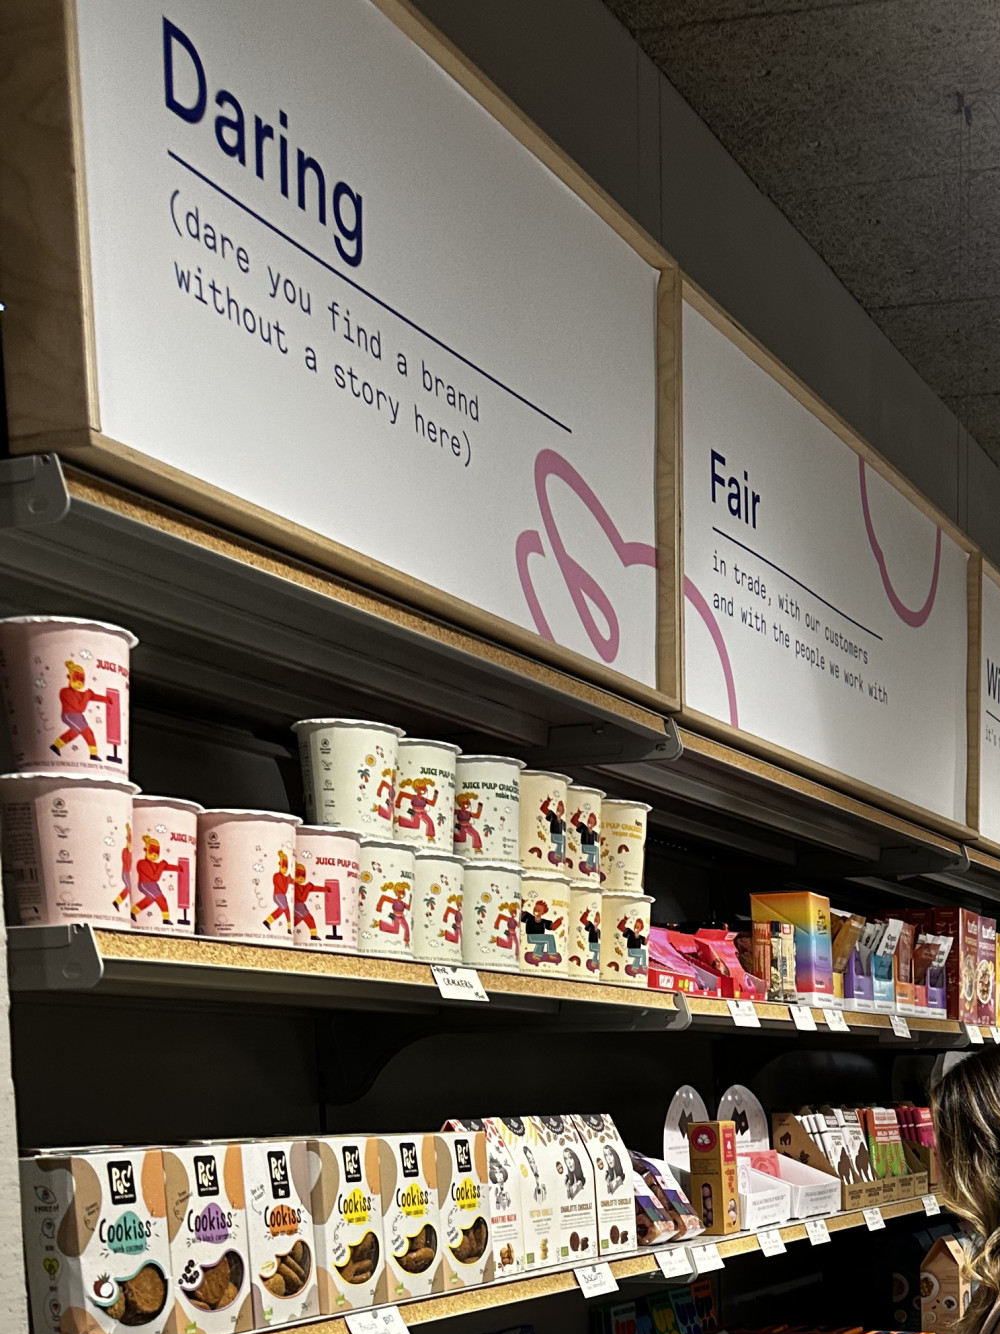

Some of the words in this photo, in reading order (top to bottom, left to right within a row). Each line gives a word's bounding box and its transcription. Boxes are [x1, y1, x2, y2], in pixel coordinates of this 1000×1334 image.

[162, 16, 364, 268] Daring
[170, 189, 250, 274] (dare
[267, 265, 312, 316] you
[328, 301, 382, 361] find
[396, 352, 408, 377] a
[421, 360, 480, 423] brand
[174, 261, 289, 355] without
[304, 346, 317, 373] a
[334, 363, 400, 425] story
[413, 404, 472, 467] here)
[710, 448, 761, 530] Fair
[712, 550, 727, 577] in
[733, 563, 772, 607] trade,
[777, 594, 801, 622] with
[804, 612, 821, 633] our
[824, 626, 869, 665] customers
[713, 592, 734, 617] and
[740, 606, 767, 636] with
[772, 622, 790, 649] the
[795, 639, 826, 671] people
[829, 660, 840, 679] we
[843, 669, 864, 694] work
[867, 681, 888, 705] with
[420, 767, 438, 776] JUICE
[461, 781, 480, 790] JUICE
[481, 782, 498, 790] PULP
[315, 857, 336, 867] JUICE
[337, 859, 352, 869] PULP
